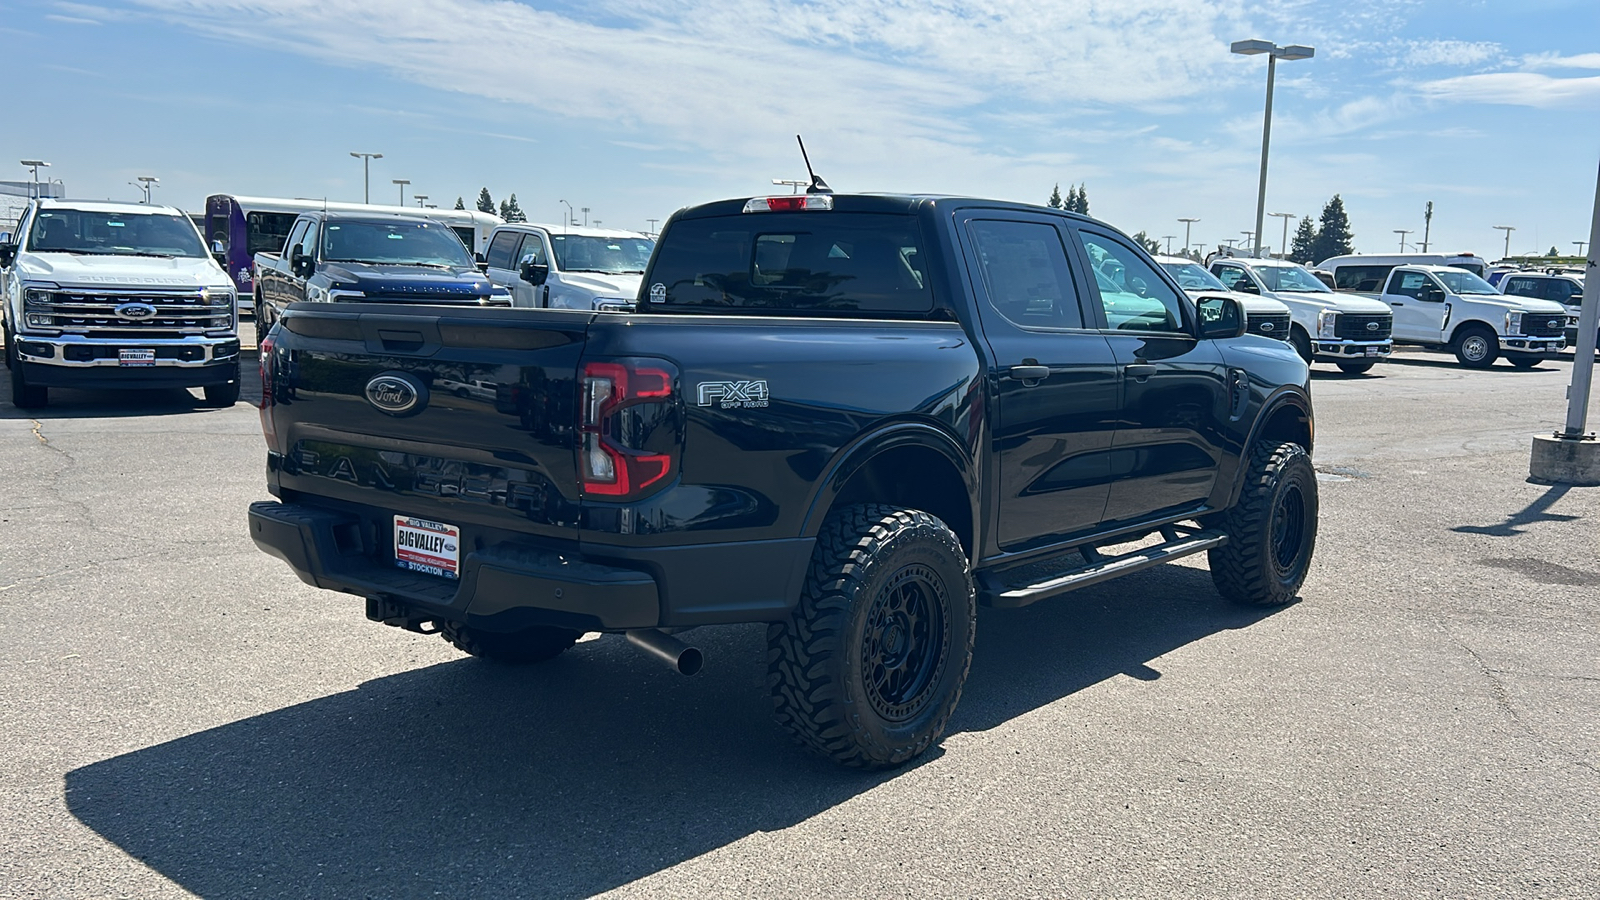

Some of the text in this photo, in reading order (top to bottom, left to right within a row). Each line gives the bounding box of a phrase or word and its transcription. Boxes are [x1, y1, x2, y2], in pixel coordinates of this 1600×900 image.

[375, 382, 403, 403] Ford
[697, 380, 769, 407] FX4
[721, 401, 769, 409] OFF ROAD
[409, 519, 443, 531] BIG VALLEY
[399, 530, 445, 553] BIGVALLEY
[408, 562, 443, 576] STOCKTON
